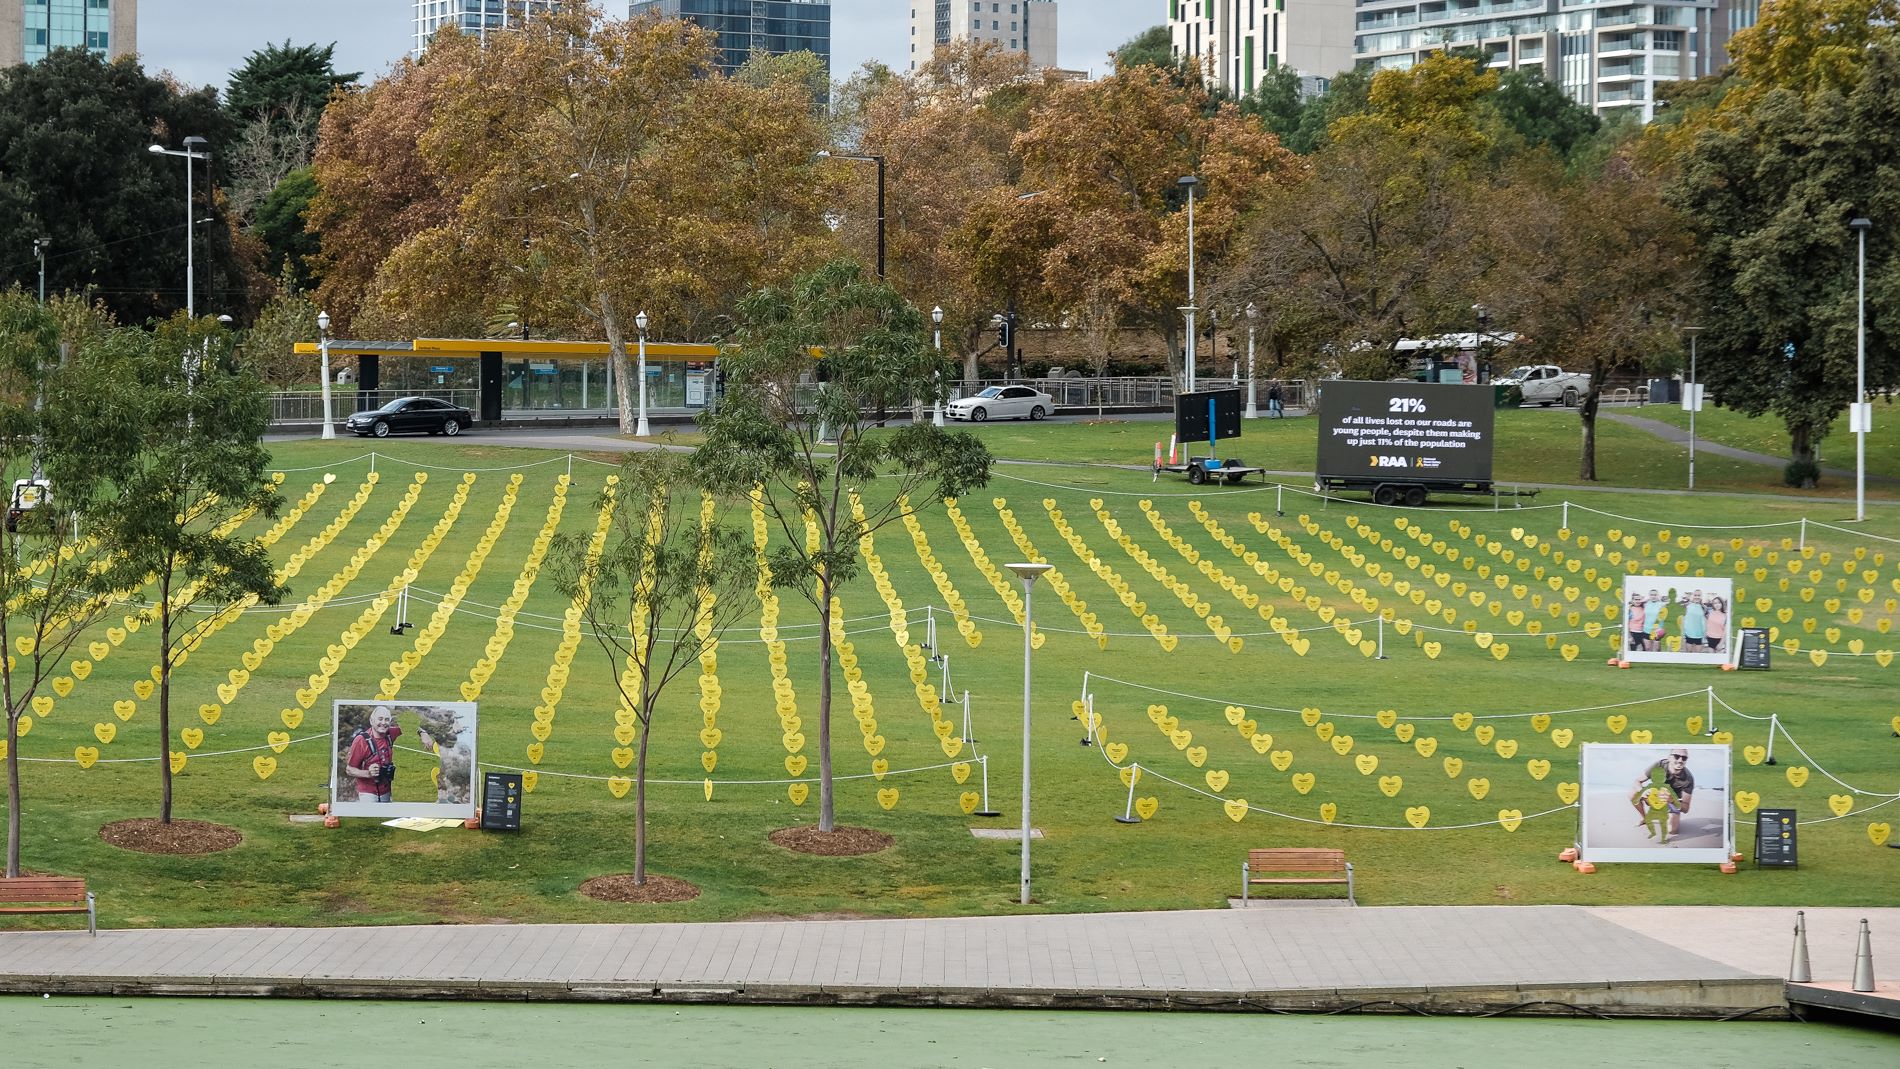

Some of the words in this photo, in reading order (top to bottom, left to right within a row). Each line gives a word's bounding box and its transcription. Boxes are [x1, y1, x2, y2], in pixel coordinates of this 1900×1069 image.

[1389, 398, 1426, 413] 21%
[1342, 416, 1352, 424] of
[1352, 416, 1363, 424] all
[1365, 417, 1385, 425] lives
[1386, 417, 1402, 425] lost
[1433, 419, 1456, 427] roads
[1333, 427, 1359, 436] young
[1360, 428, 1391, 436] people,
[1393, 428, 1424, 437] despite
[1426, 429, 1448, 437] them
[1449, 430, 1480, 440] making
[1347, 438, 1358, 446] up
[1359, 438, 1376, 446] just
[1420, 440, 1466, 448] population
[1379, 456, 1407, 467] RAA
